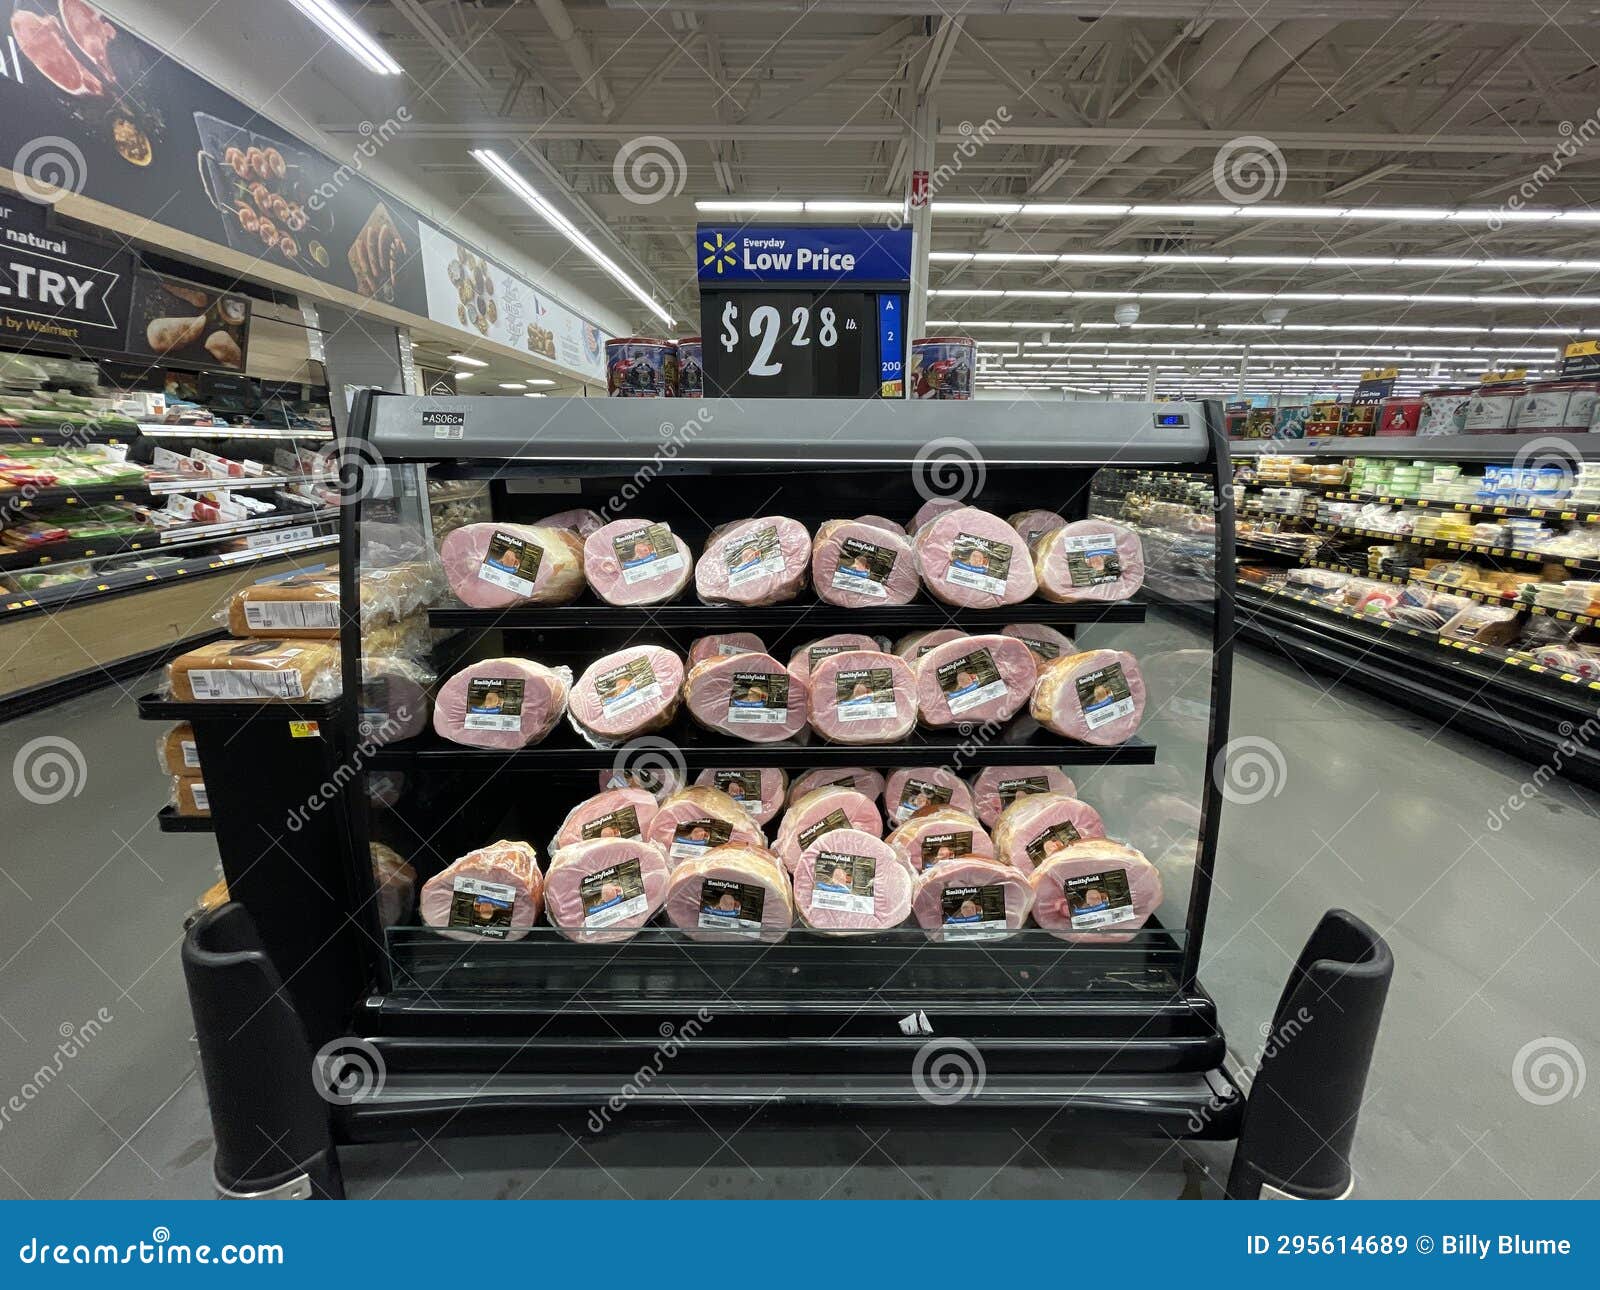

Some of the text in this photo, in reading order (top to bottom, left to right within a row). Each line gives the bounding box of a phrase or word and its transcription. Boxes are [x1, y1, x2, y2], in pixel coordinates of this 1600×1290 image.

[6, 229, 66, 254] natural
[743, 238, 785, 249] Everyday
[743, 248, 855, 270] Low Price
[6, 317, 78, 337] by Walmart
[887, 332, 894, 341] 2
[882, 362, 901, 371] 200
[474, 679, 501, 687] Smithfield
[708, 880, 739, 889] Smithfield
[1068, 876, 1099, 886] Smithfield
[945, 888, 978, 896] Smithfield
